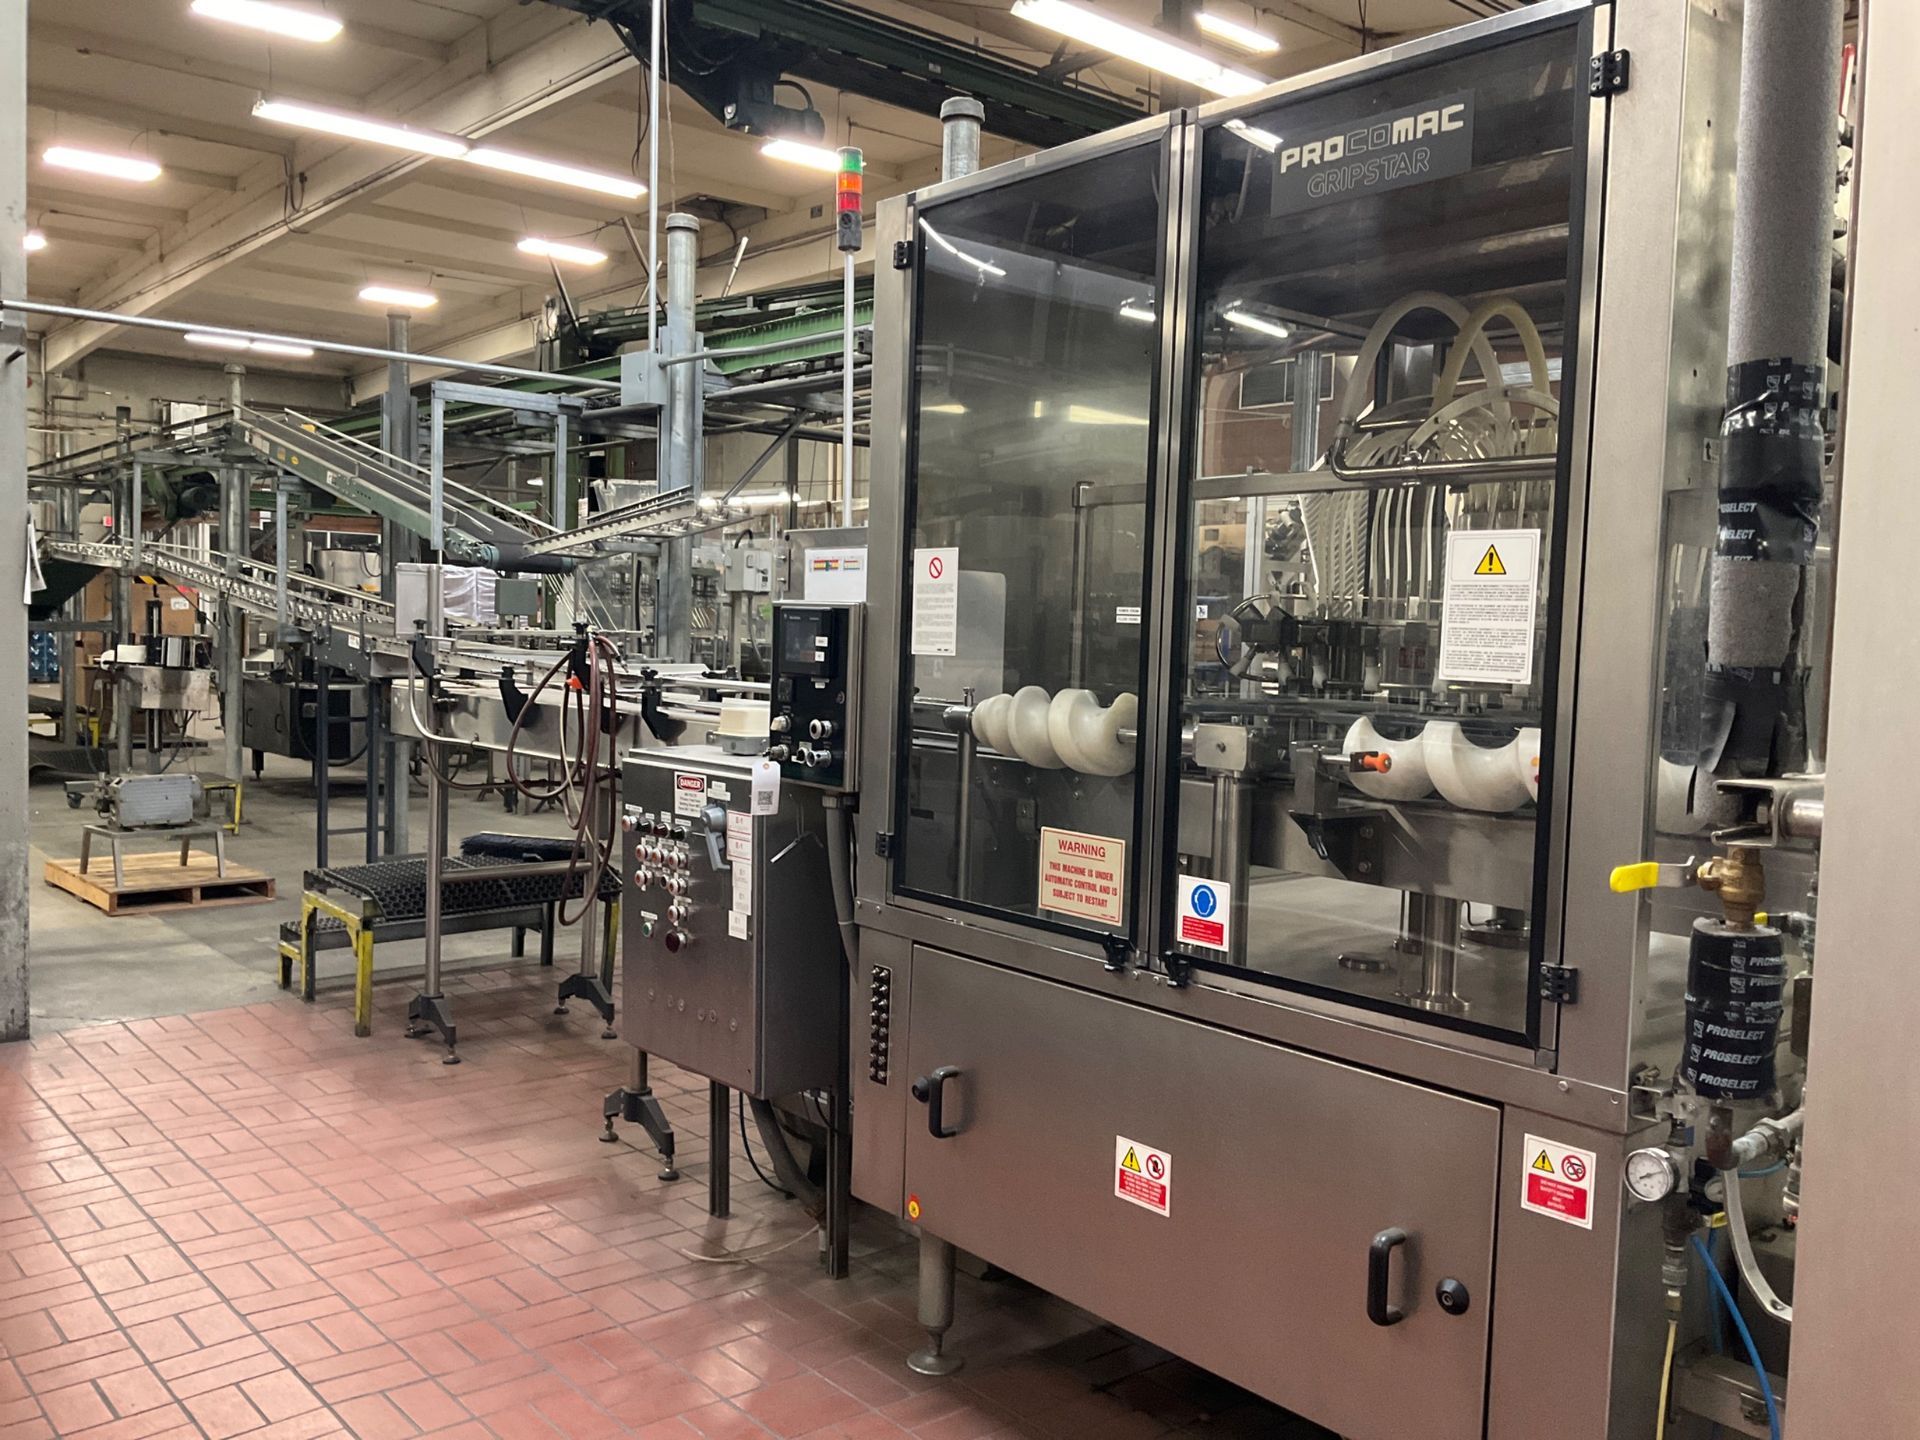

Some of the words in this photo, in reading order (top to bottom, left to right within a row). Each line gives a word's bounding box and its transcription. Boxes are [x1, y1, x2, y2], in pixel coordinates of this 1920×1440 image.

[1280, 103, 1465, 174] PROCOMAC
[1307, 147, 1431, 198] GRIPSTAR
[680, 778, 701, 789] DANGER
[1058, 839, 1106, 858] WARNING
[1049, 861, 1061, 871] THIS
[1062, 864, 1086, 876] MACHINE
[1088, 869, 1093, 878] IS
[1095, 870, 1113, 882] UNDER
[1045, 873, 1073, 887] AUTOMATIC
[1074, 880, 1098, 892] CONTROL
[1099, 885, 1110, 895] AND
[1112, 887, 1117, 896] IS
[1053, 888, 1076, 900] SUBJECT
[1077, 893, 1083, 902] TO
[1085, 895, 1107, 908] RESTART
[1706, 1023, 1765, 1041] PROSELECT
[1703, 1048, 1761, 1065] PROSELECT
[1699, 1072, 1759, 1090] PROSELECT
